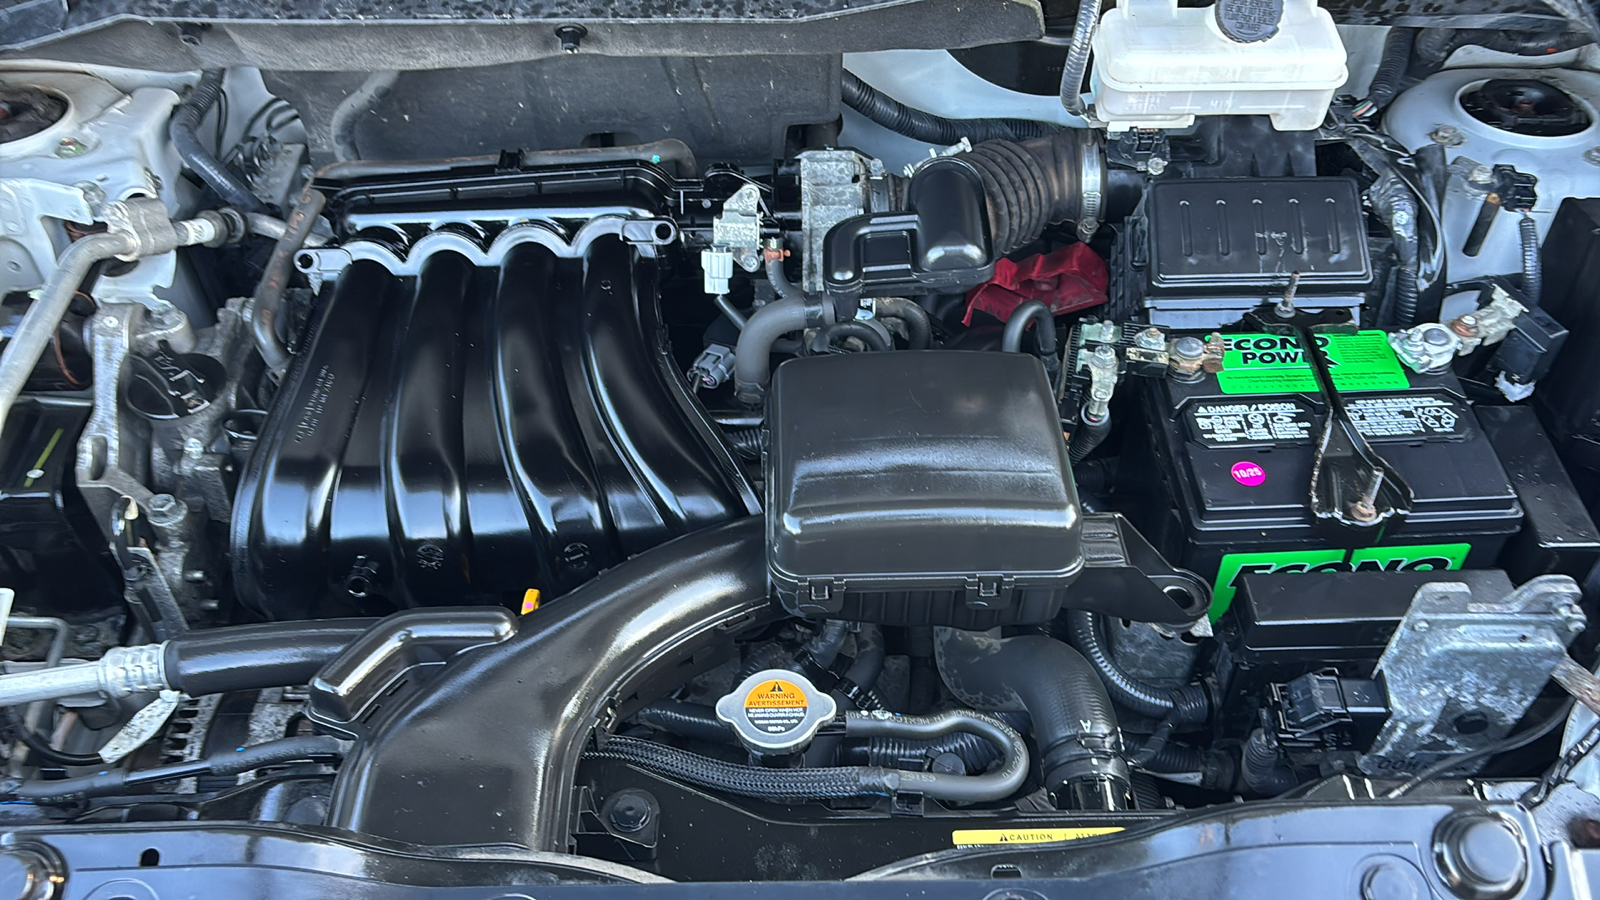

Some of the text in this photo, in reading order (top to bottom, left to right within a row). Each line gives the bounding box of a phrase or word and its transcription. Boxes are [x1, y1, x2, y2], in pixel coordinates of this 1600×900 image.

[1207, 404, 1249, 413] DANGER
[1258, 403, 1296, 411] POISON
[1233, 467, 1263, 479] 10/25
